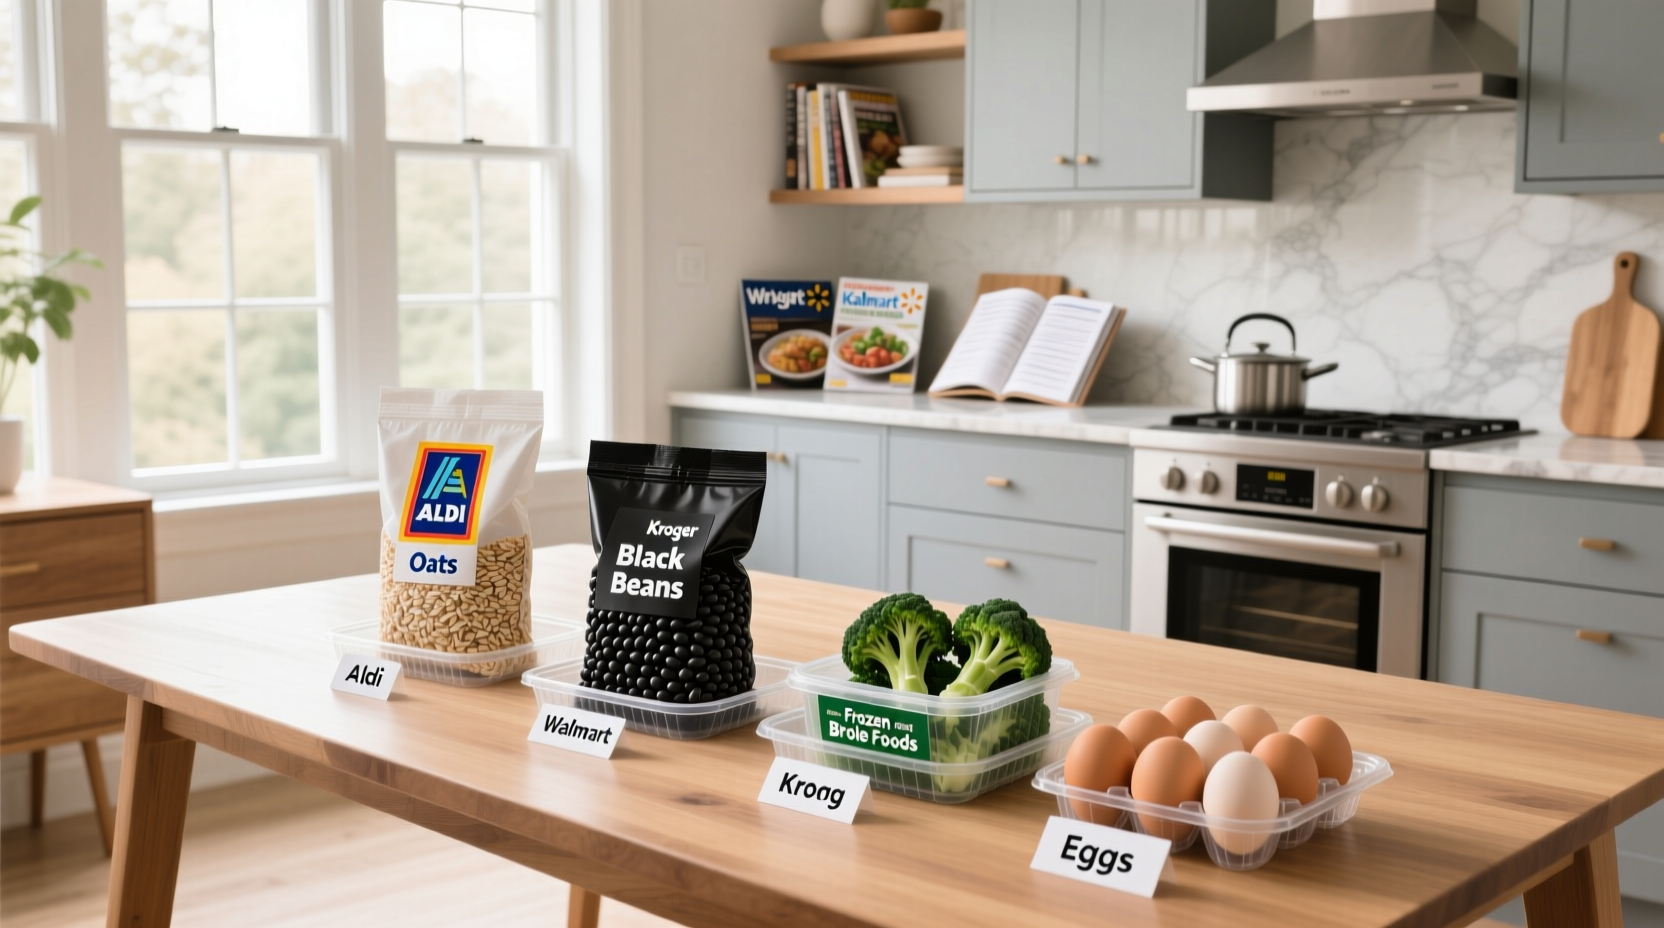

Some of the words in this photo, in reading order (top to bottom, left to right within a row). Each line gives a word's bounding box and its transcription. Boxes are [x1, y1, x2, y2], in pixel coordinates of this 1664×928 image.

[842, 291, 899, 309] Kalmart
[415, 503, 466, 523] ALDI
[646, 519, 699, 541] Kroger
[409, 552, 458, 574] Oats
[615, 543, 685, 570] Black
[610, 571, 684, 599] Beans
[345, 664, 385, 687] Aldi
[544, 714, 613, 744] Walmart
[829, 720, 869, 743] Brole
[872, 729, 918, 752] Foods
[1060, 834, 1134, 875] Eggs
